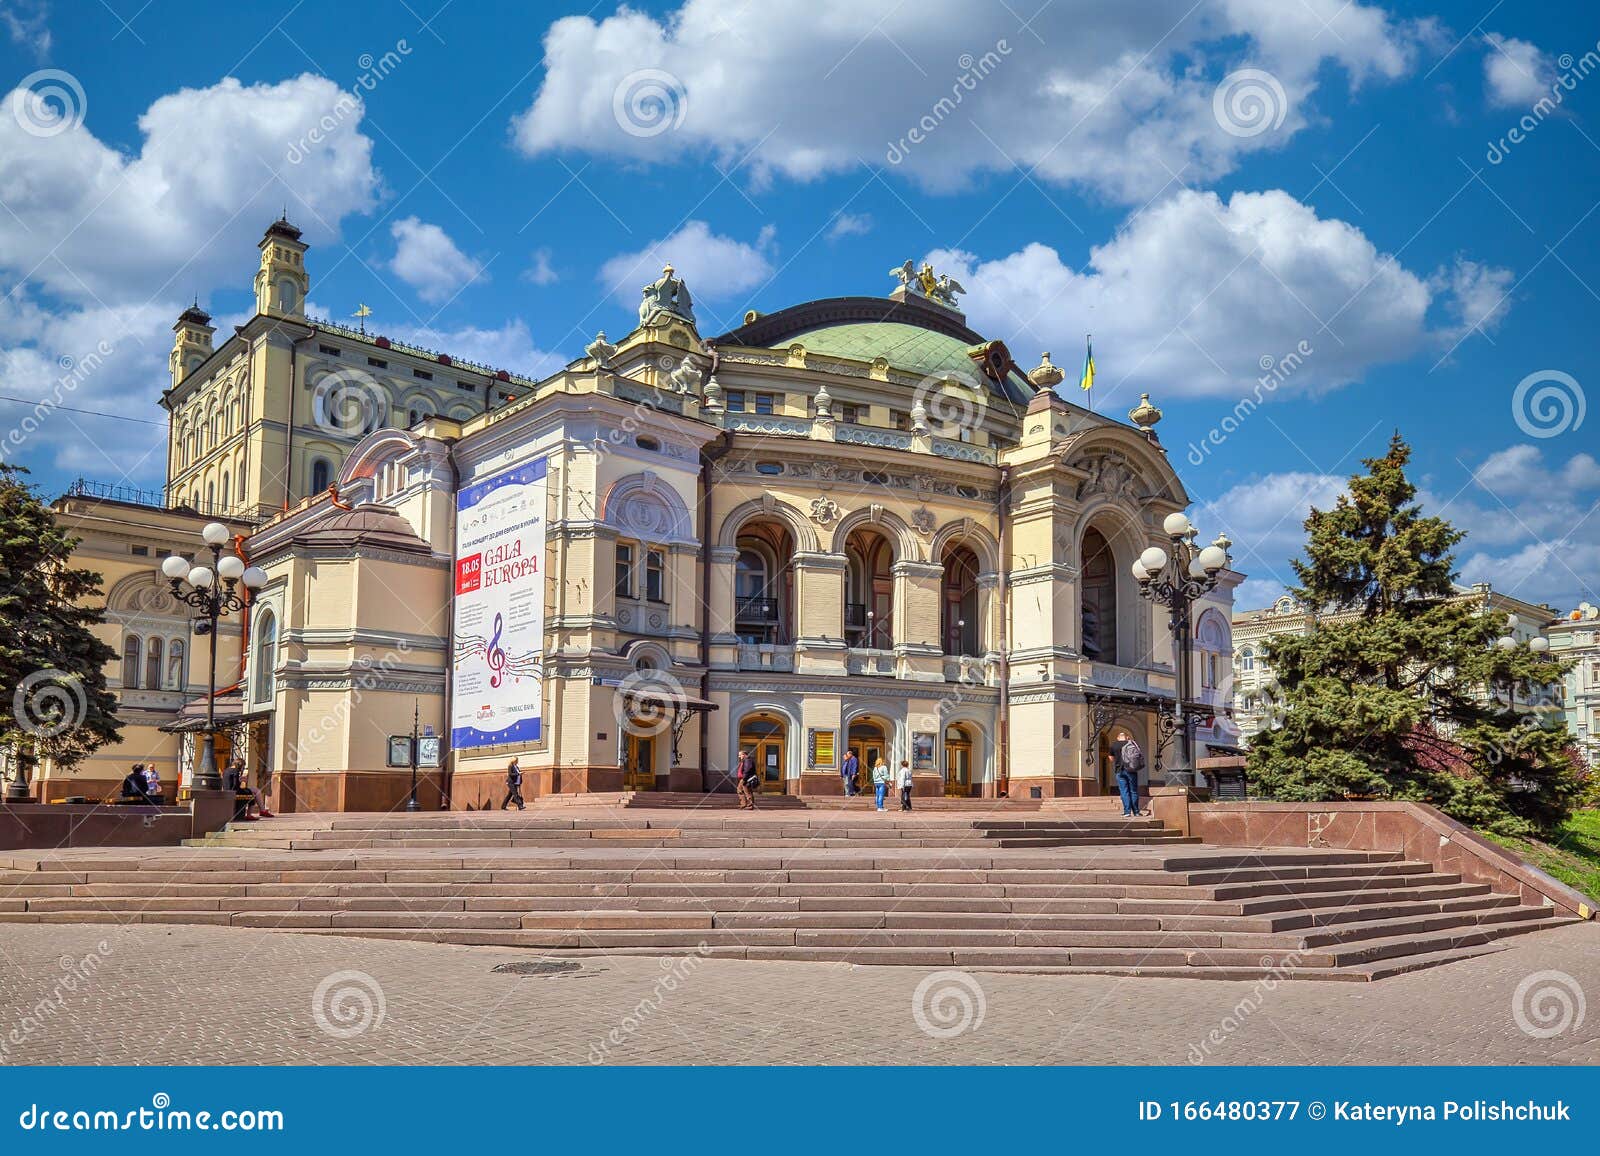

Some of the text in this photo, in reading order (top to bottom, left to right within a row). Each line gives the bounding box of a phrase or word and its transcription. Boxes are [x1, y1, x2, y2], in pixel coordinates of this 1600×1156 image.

[461, 558, 480, 575] 18.05
[484, 539, 522, 567] GALA
[484, 555, 538, 588] EUROPA
